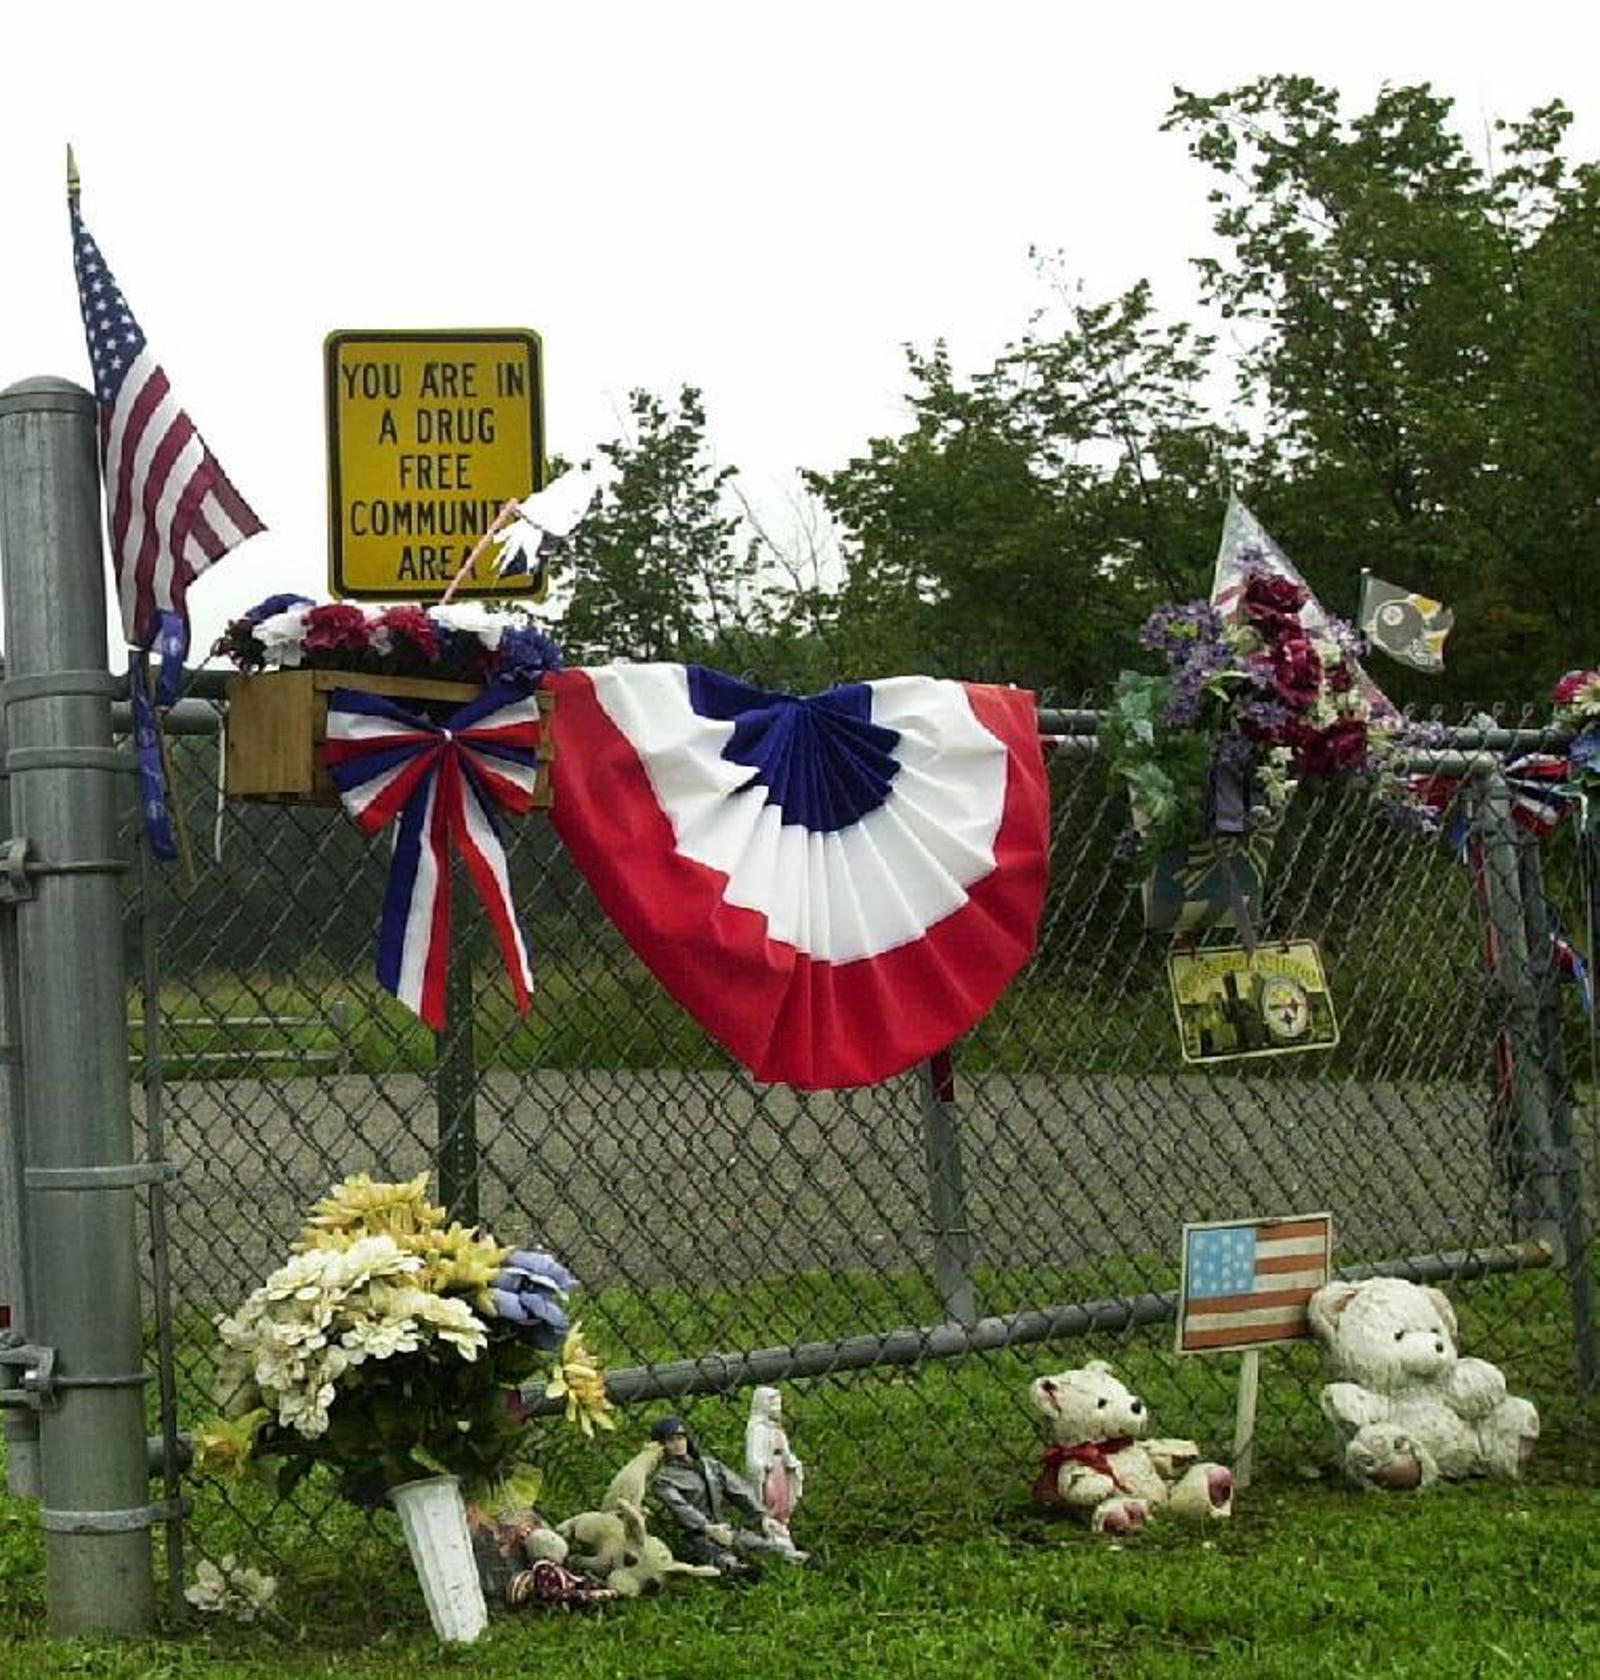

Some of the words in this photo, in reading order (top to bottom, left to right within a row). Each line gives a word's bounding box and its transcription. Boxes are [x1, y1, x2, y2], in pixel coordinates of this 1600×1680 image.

[342, 363, 400, 399] YOU
[419, 363, 478, 398] ARE
[497, 363, 524, 397] IN
[378, 409, 398, 445] A
[417, 408, 495, 444] DRUG
[400, 455, 473, 490] FREE
[351, 500, 526, 536] COMMUNIT
[397, 546, 478, 581] AREA
